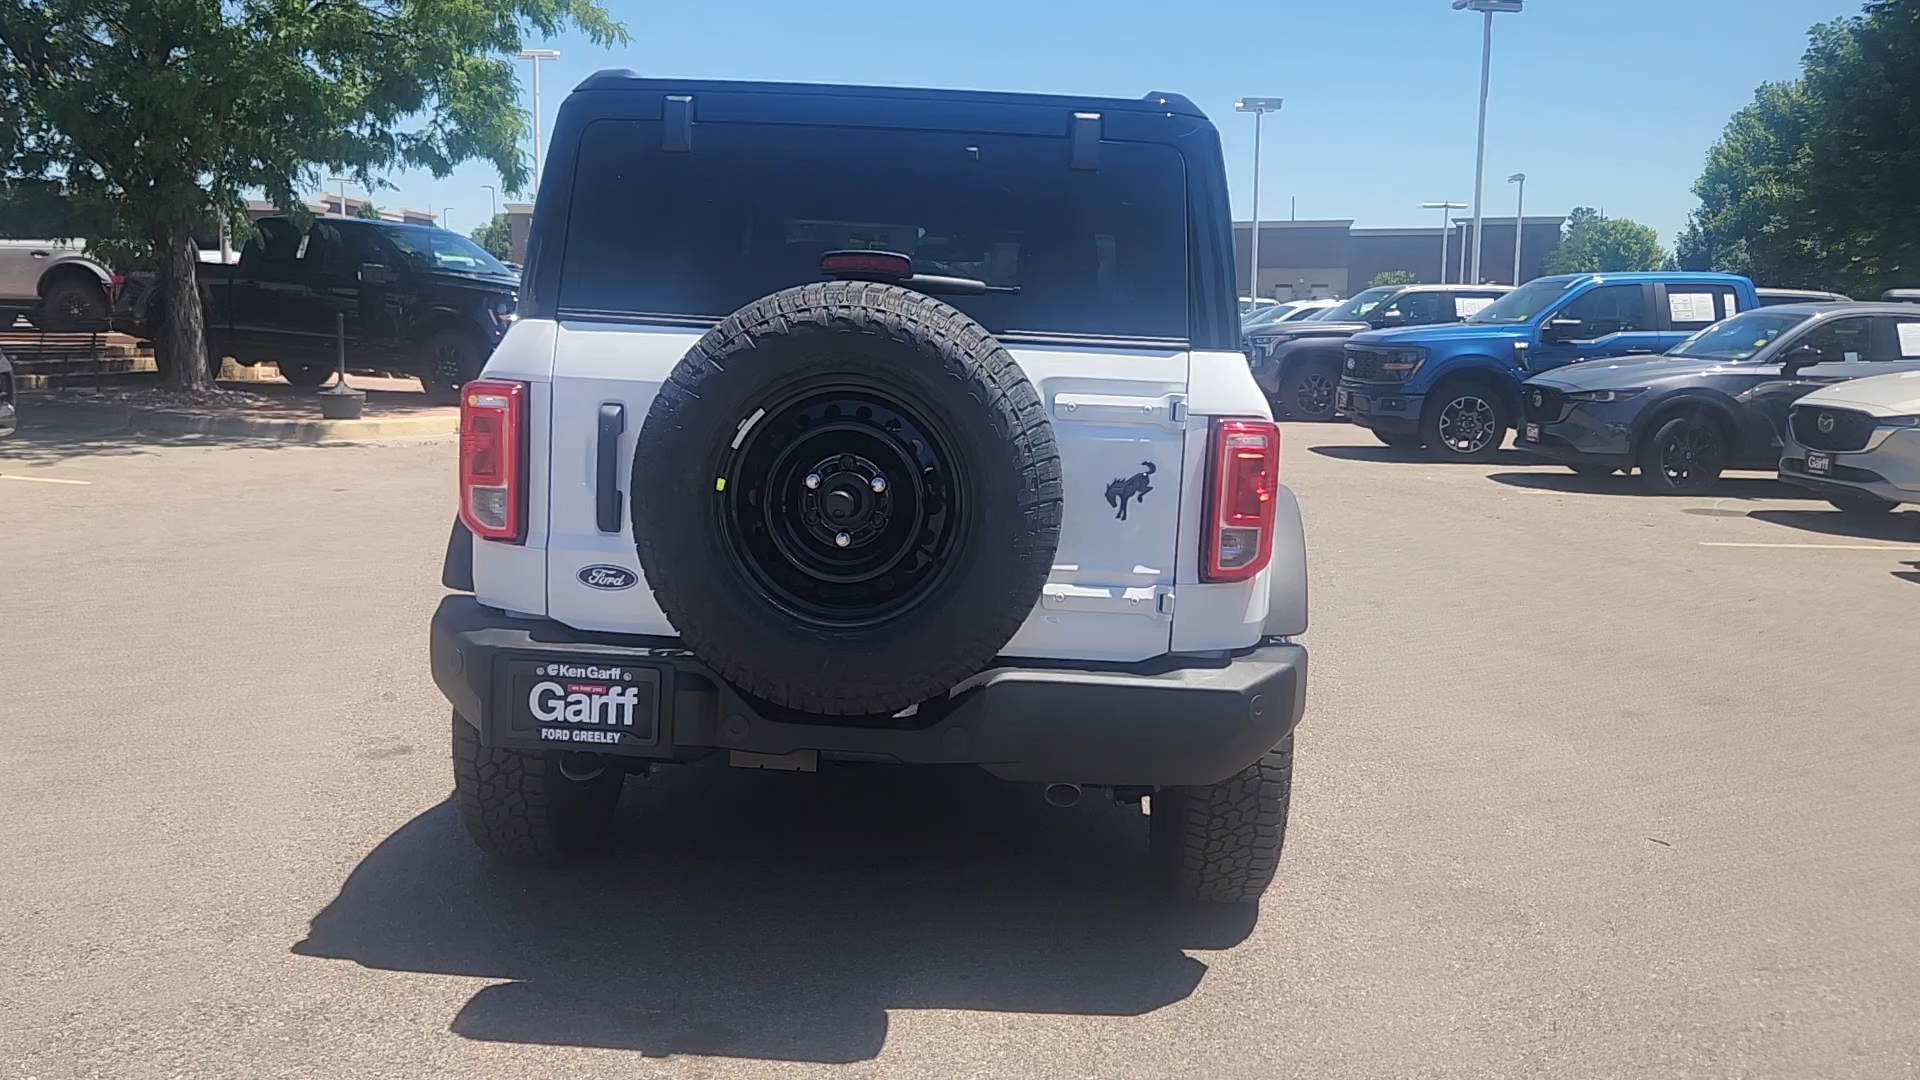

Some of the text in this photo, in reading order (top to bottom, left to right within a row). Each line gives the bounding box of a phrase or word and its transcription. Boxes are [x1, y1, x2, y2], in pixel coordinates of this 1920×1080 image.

[588, 568, 626, 586] Ford
[559, 664, 621, 680] Ken Garff
[529, 681, 639, 726] Garff
[541, 728, 621, 744] FORD GREELEY
